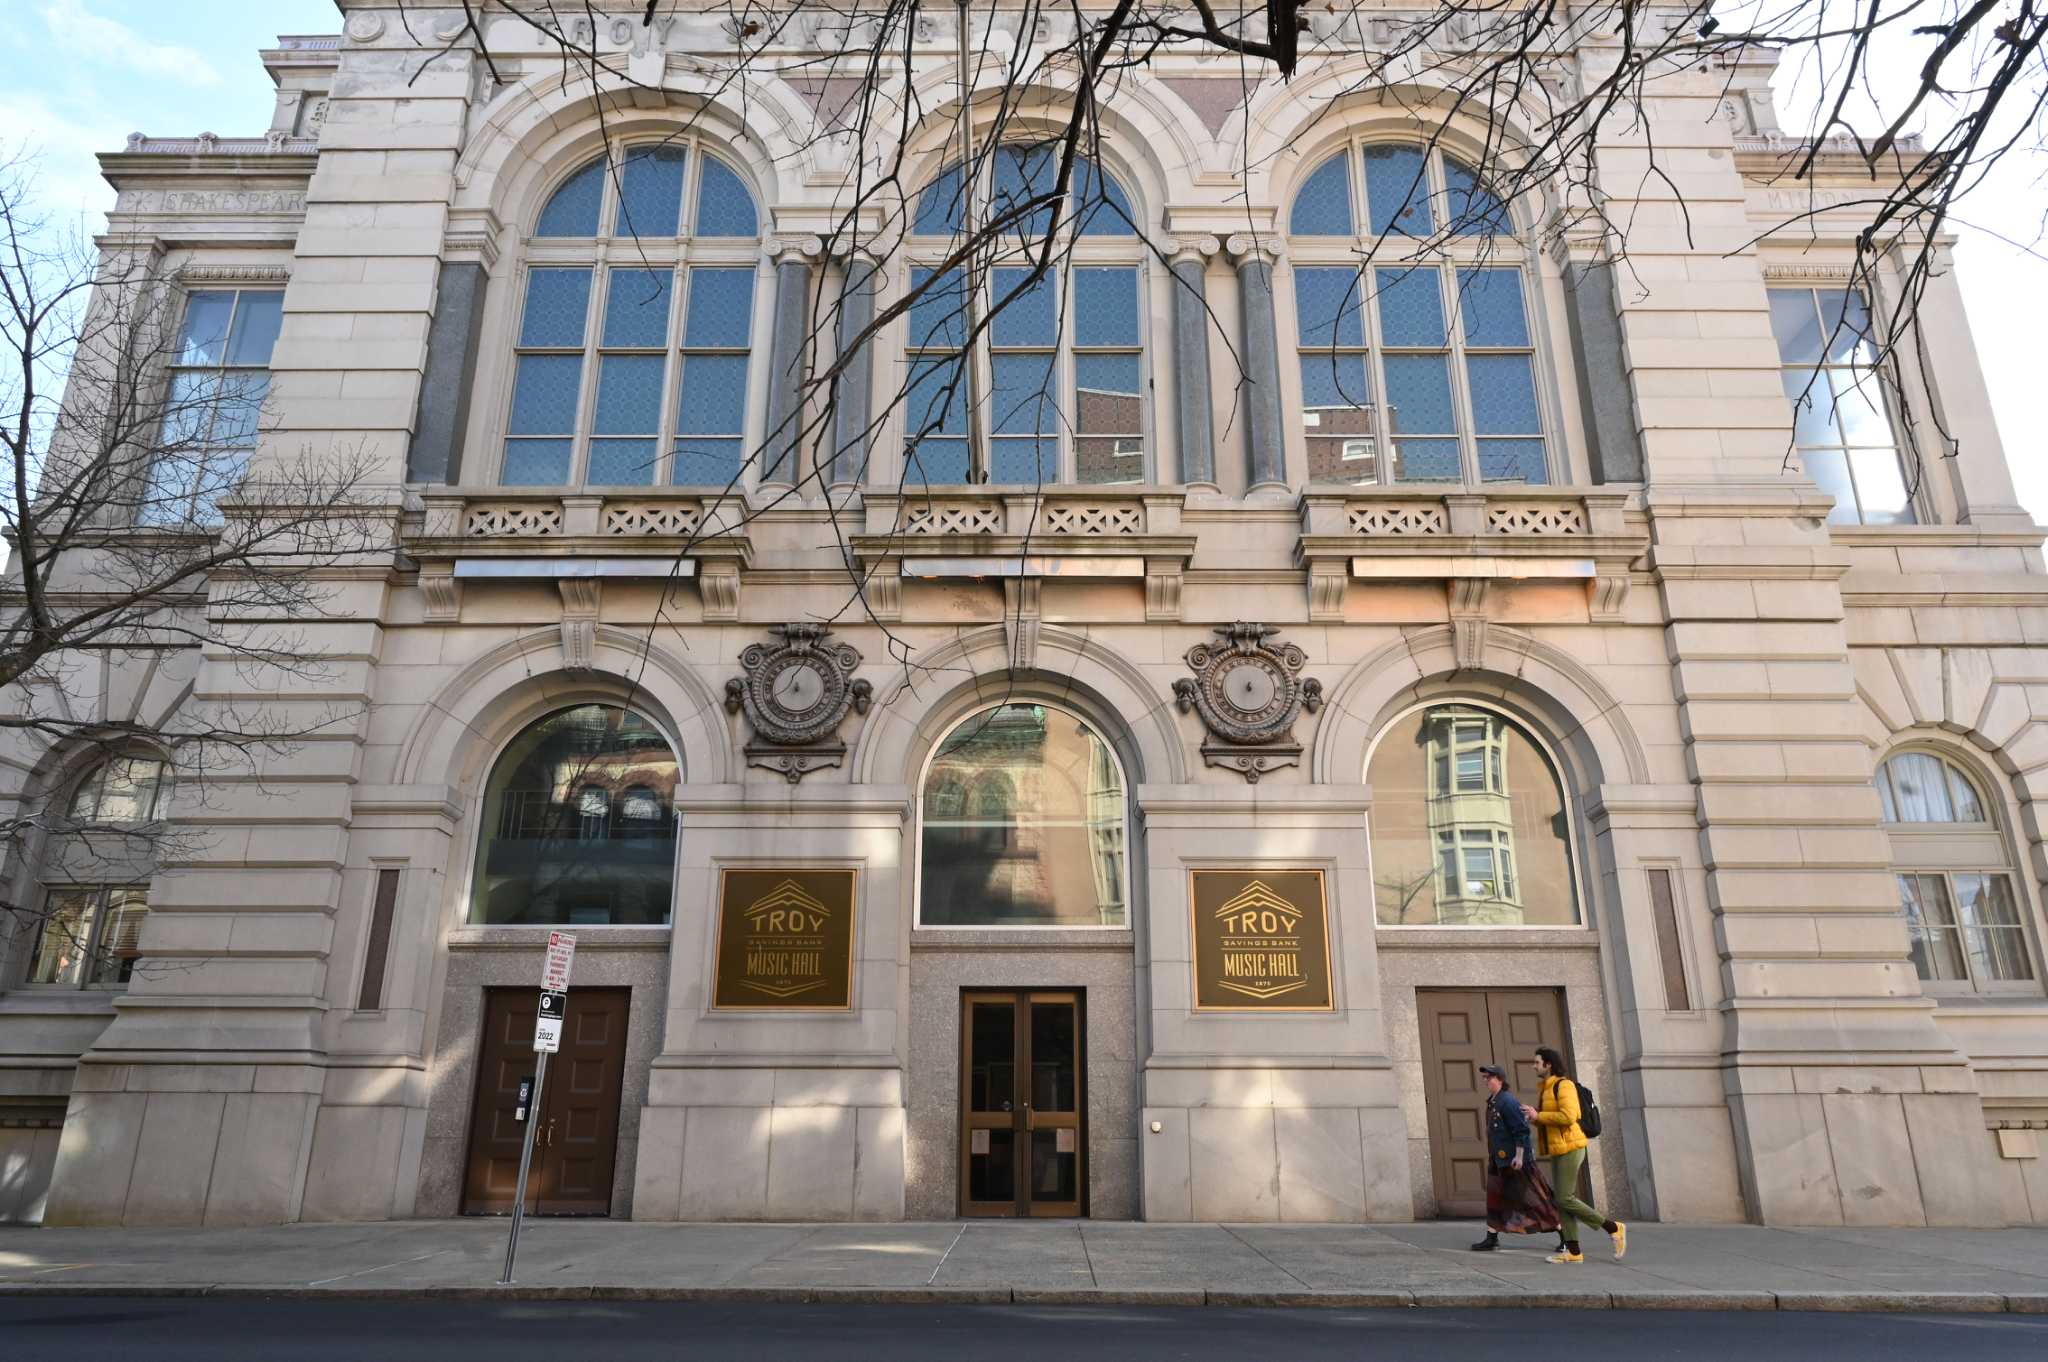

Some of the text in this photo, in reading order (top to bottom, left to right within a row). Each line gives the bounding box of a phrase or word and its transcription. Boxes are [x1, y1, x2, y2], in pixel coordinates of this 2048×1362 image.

[535, 18, 677, 46] TROY
[750, 910, 824, 932] TROY
[1223, 911, 1297, 933] TROY
[747, 952, 821, 976] MUSIC HALL
[1224, 953, 1300, 977] MUSIC HALL
[537, 1032, 553, 1041] 2022
